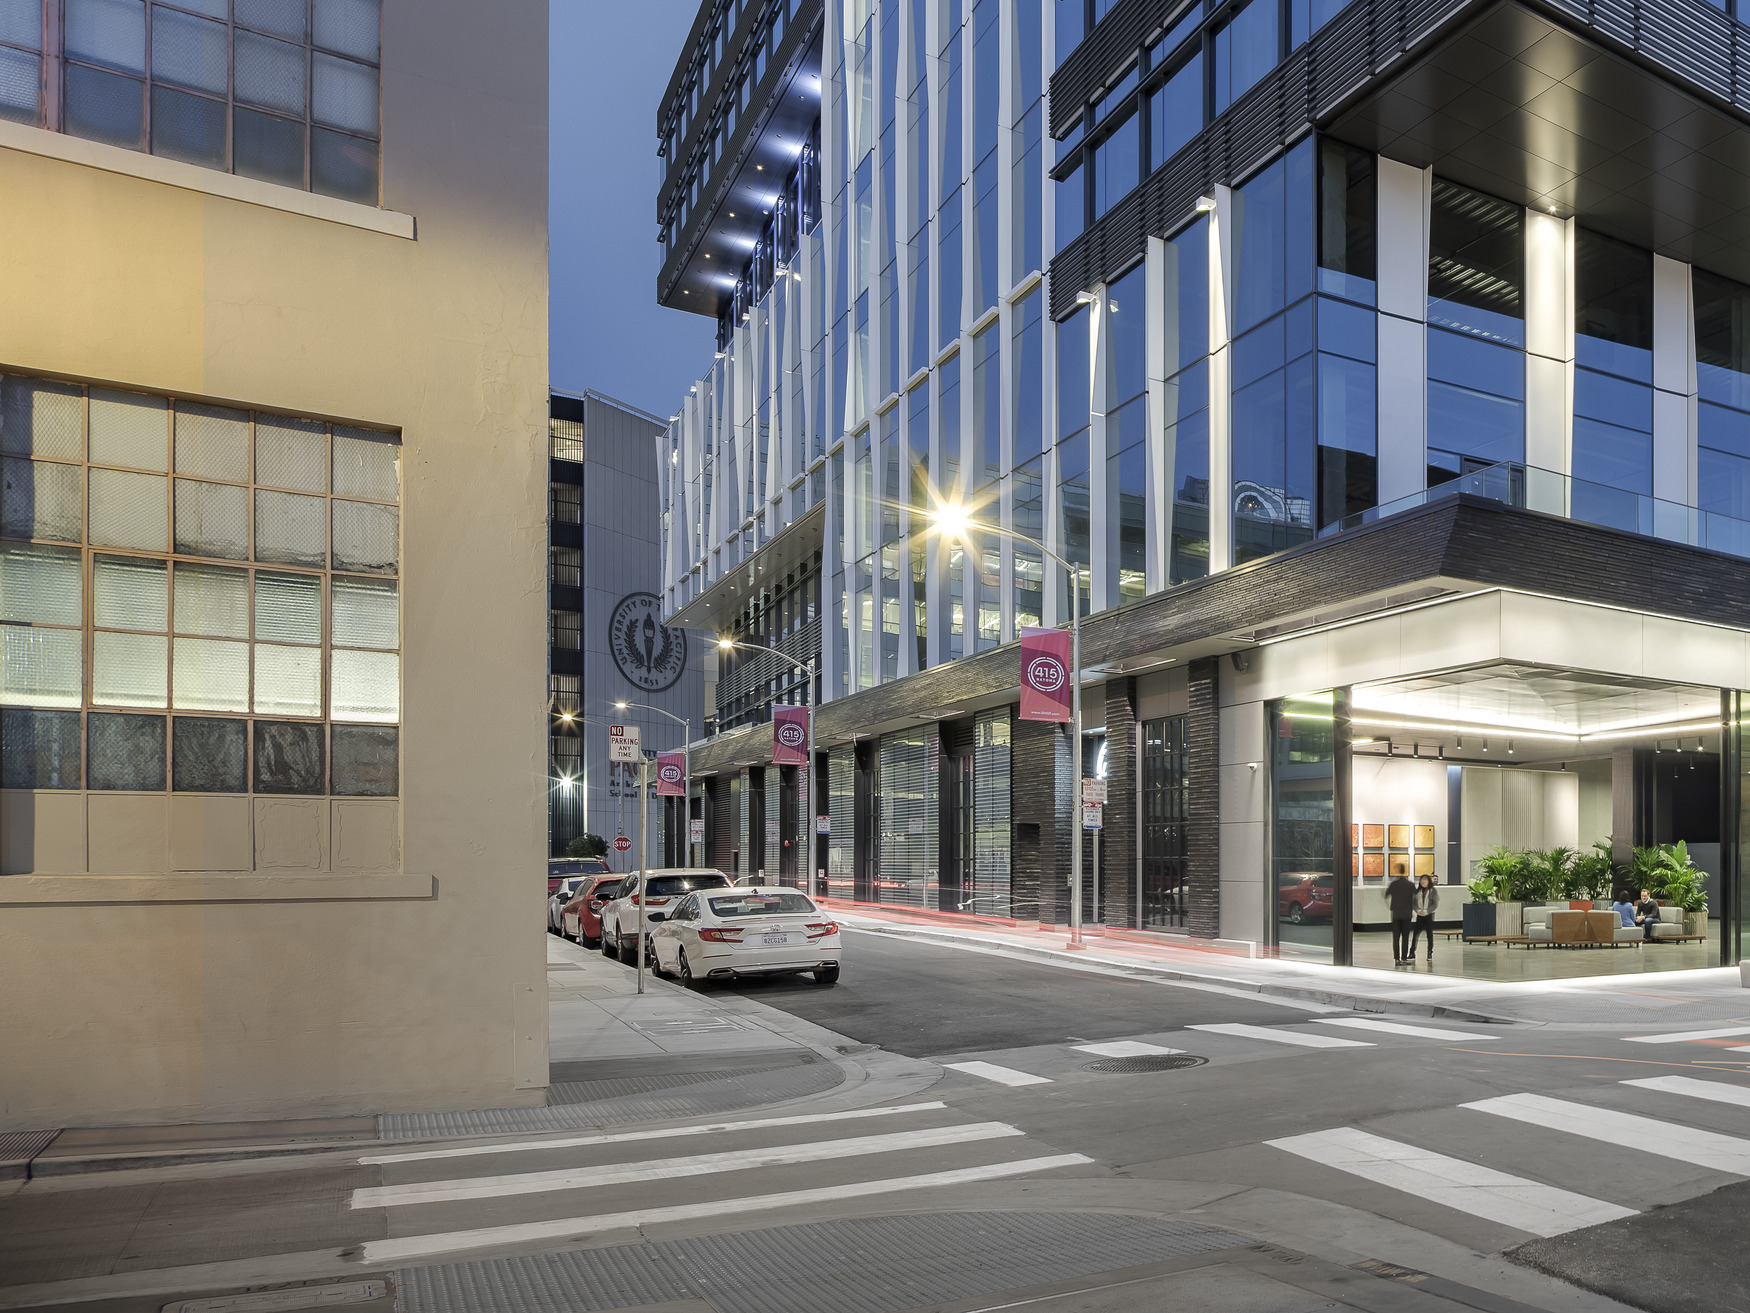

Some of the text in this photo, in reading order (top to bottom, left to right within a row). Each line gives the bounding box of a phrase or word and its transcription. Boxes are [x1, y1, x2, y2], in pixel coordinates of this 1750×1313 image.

[615, 599, 652, 665] UNIVERSITY OF
[1035, 667, 1057, 679] 415
[639, 676, 658, 686] 1851
[612, 726, 622, 735] NO
[612, 737, 638, 745] PARKING
[614, 840, 631, 848] STOP
